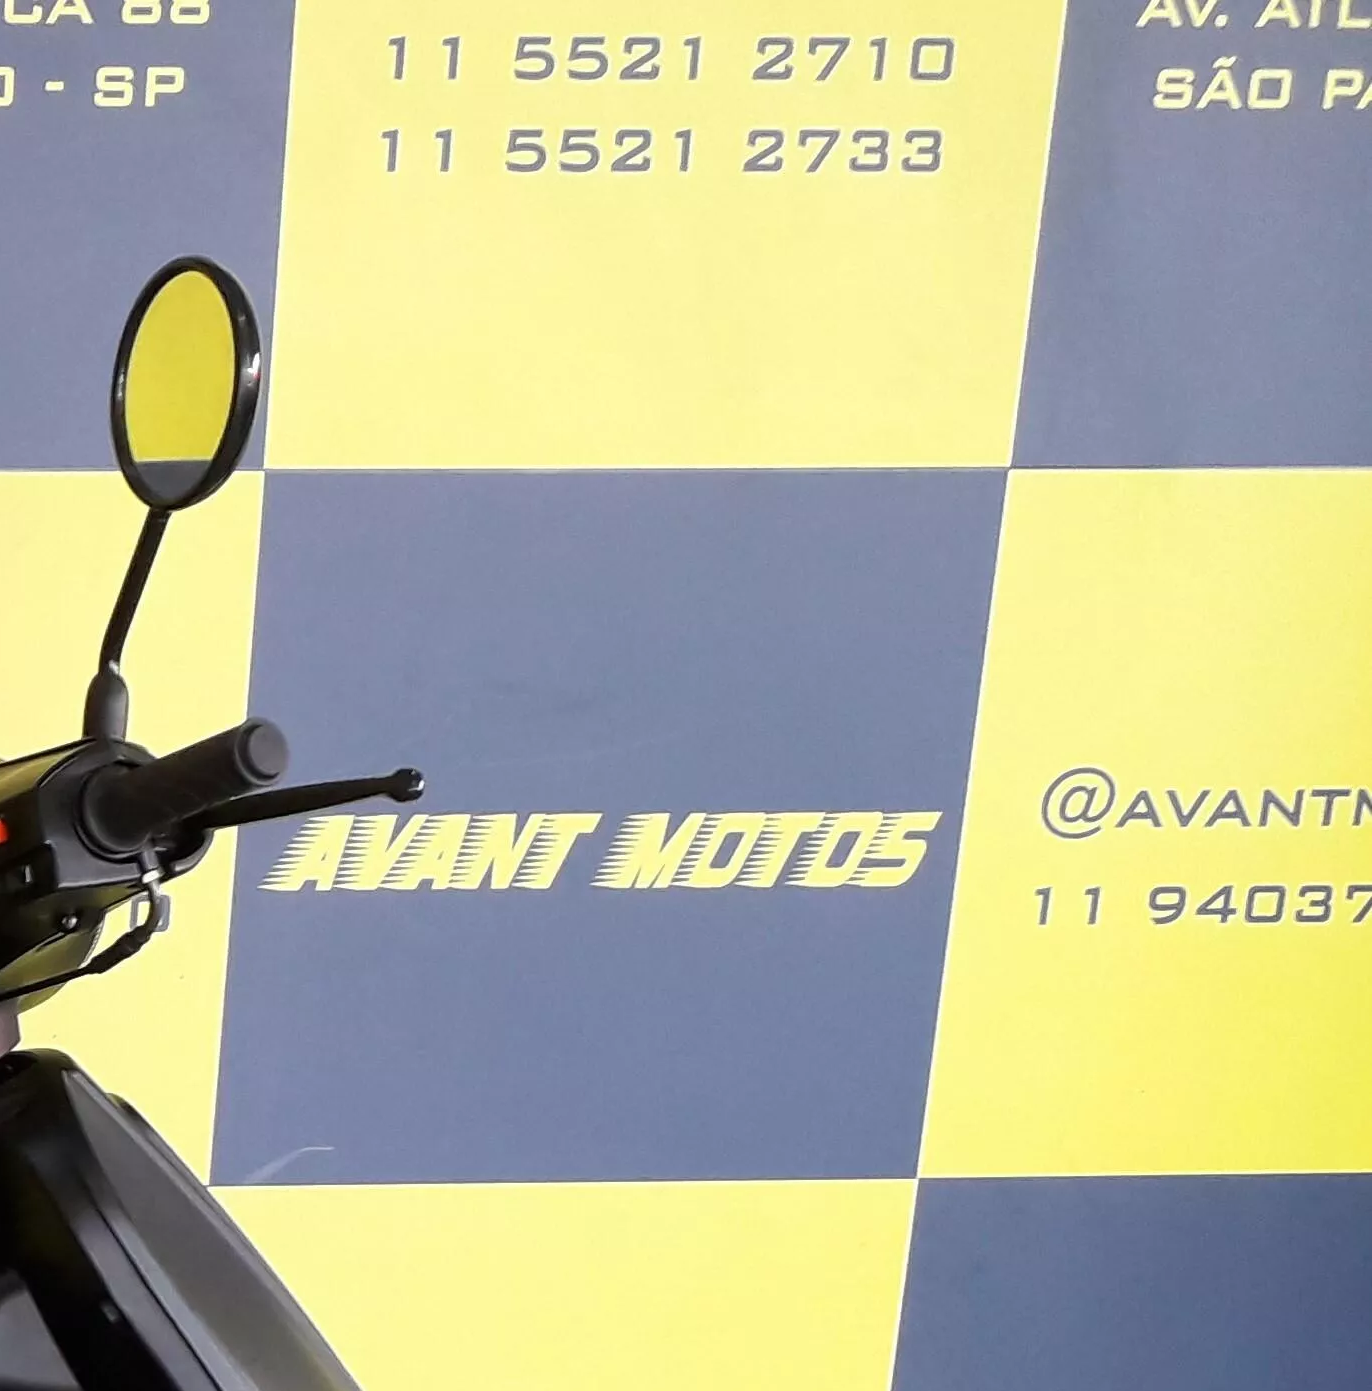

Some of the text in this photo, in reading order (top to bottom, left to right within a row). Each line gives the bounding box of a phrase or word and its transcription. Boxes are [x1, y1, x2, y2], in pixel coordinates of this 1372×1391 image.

[1135, 0, 1372, 30] AV. ATL
[387, 35, 956, 83] 11 5521 2710
[46, 79, 66, 92] -
[93, 65, 186, 108] SP
[1152, 55, 1295, 111] SÃO
[380, 128, 943, 174] 11 5521 2733
[256, 810, 943, 892] AVANT MOTOS
[1034, 883, 1372, 926] 11 94037
